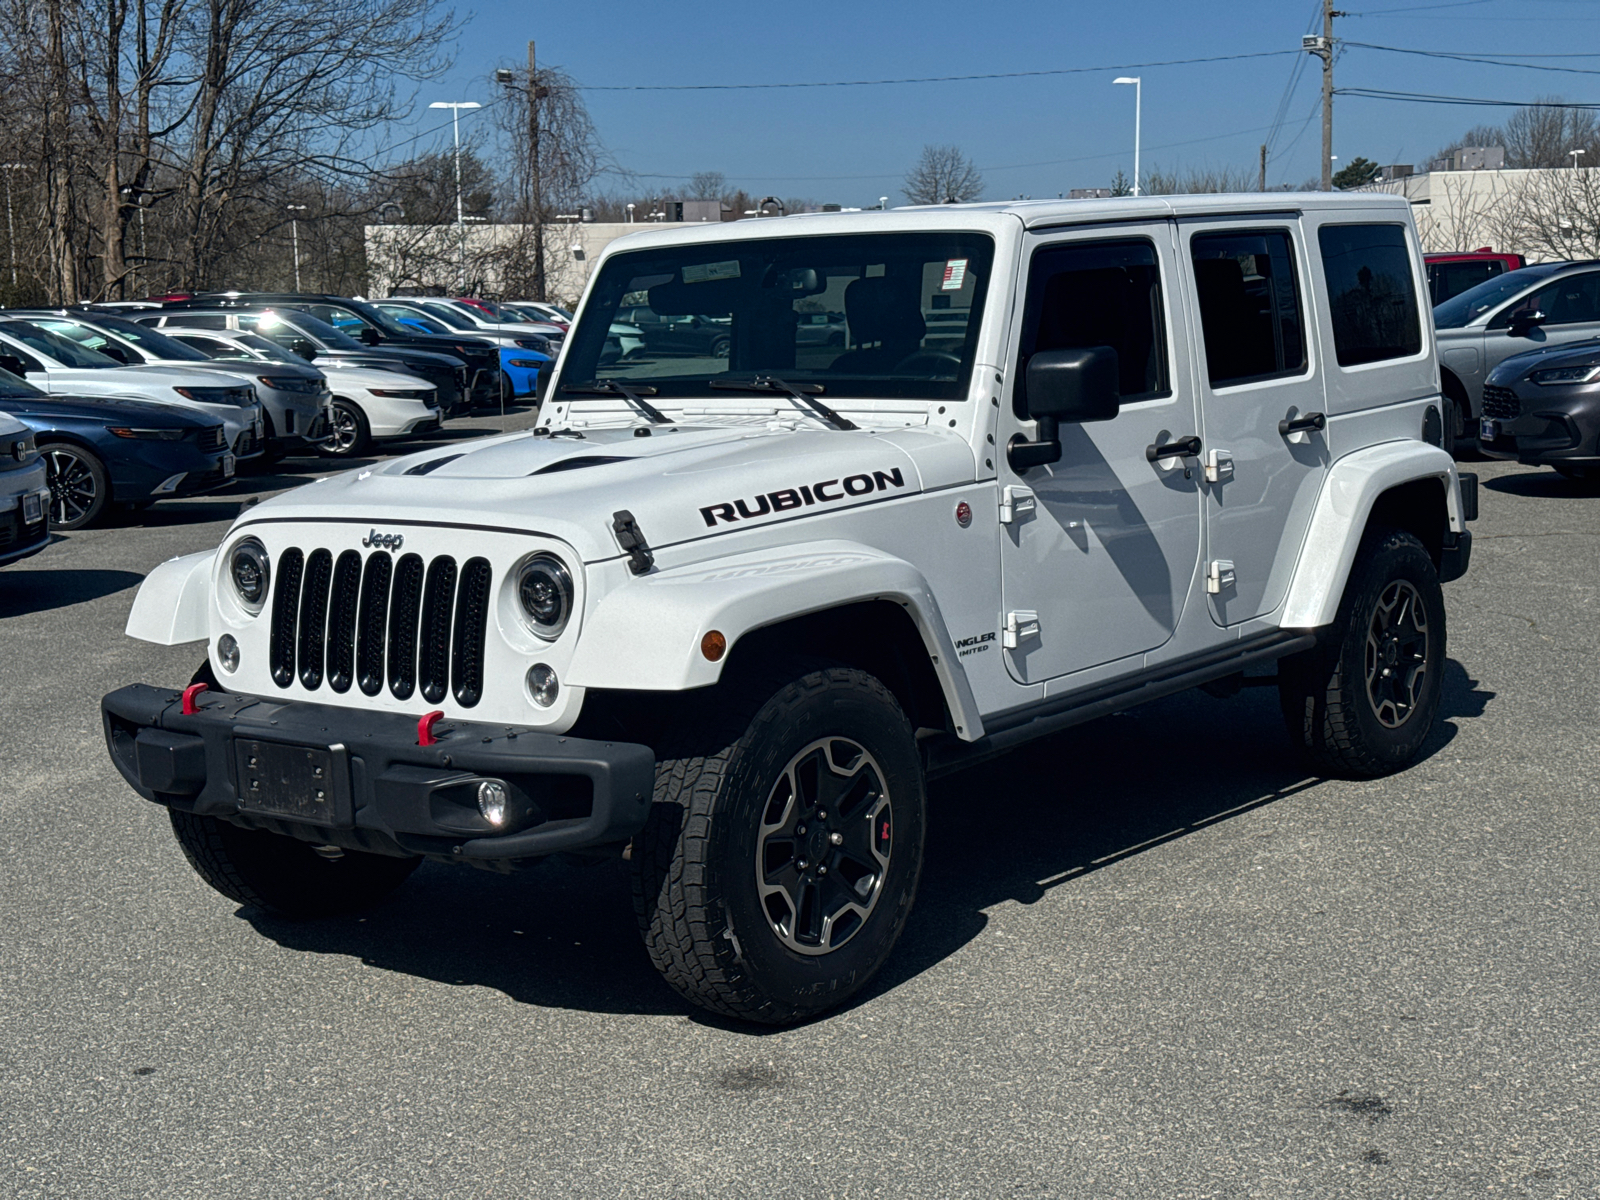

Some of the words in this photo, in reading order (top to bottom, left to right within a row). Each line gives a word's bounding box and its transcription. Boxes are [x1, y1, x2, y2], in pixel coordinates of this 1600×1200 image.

[699, 467, 905, 527] RUBICON
[362, 528, 404, 553] Jeep
[959, 645, 989, 657] IMITED
